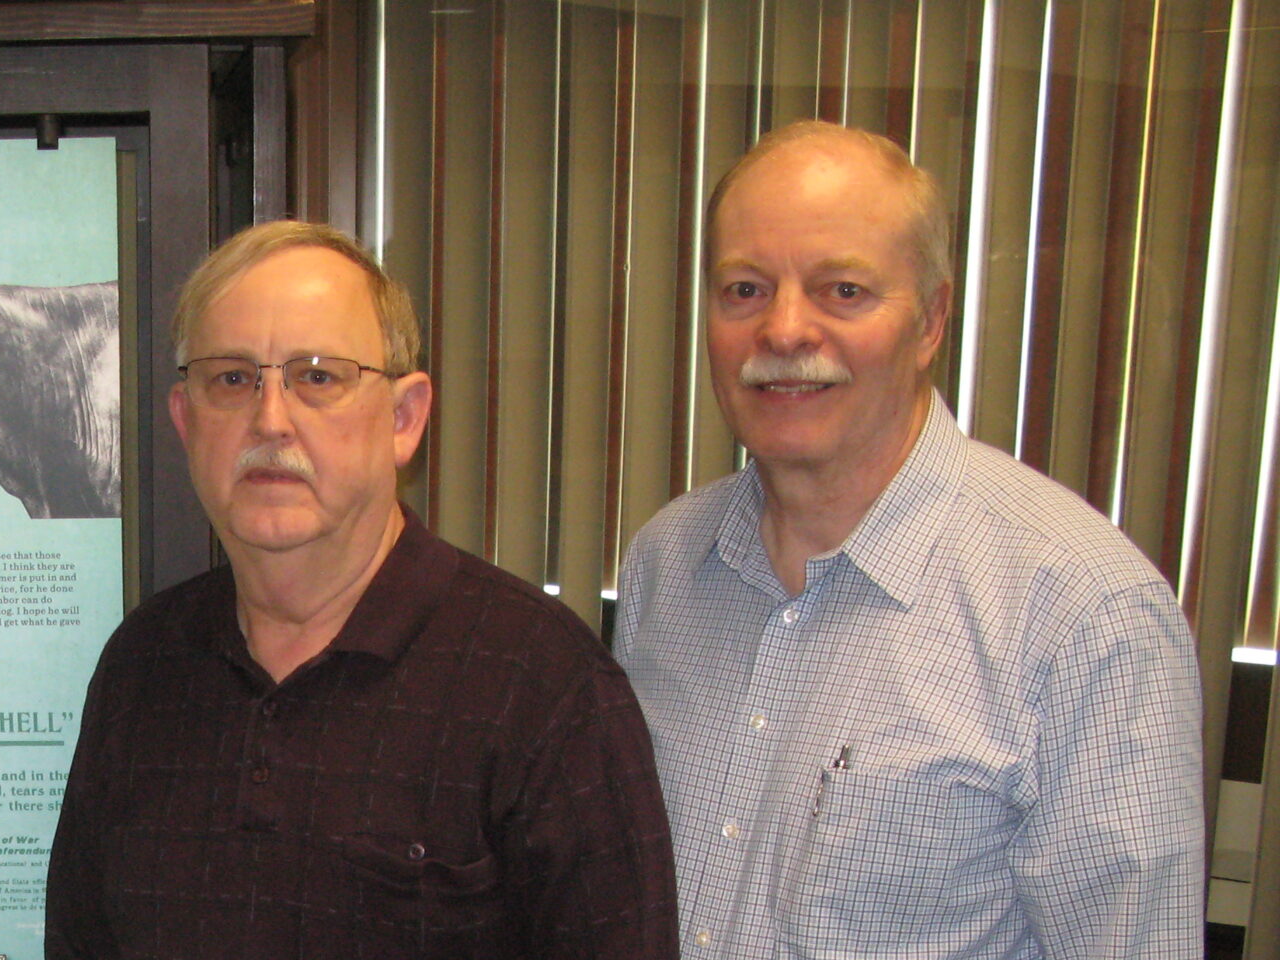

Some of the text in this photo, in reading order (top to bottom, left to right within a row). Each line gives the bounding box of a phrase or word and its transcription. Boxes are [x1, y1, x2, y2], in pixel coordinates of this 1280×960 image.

[0, 712, 73, 733] HELL”
[1, 770, 26, 781] and
[31, 770, 44, 781] in
[49, 770, 69, 781] the
[11, 787, 44, 796] tears
[49, 788, 66, 796] an
[9, 800, 43, 811] there
[2, 836, 14, 844] of
[16, 836, 40, 844] War
